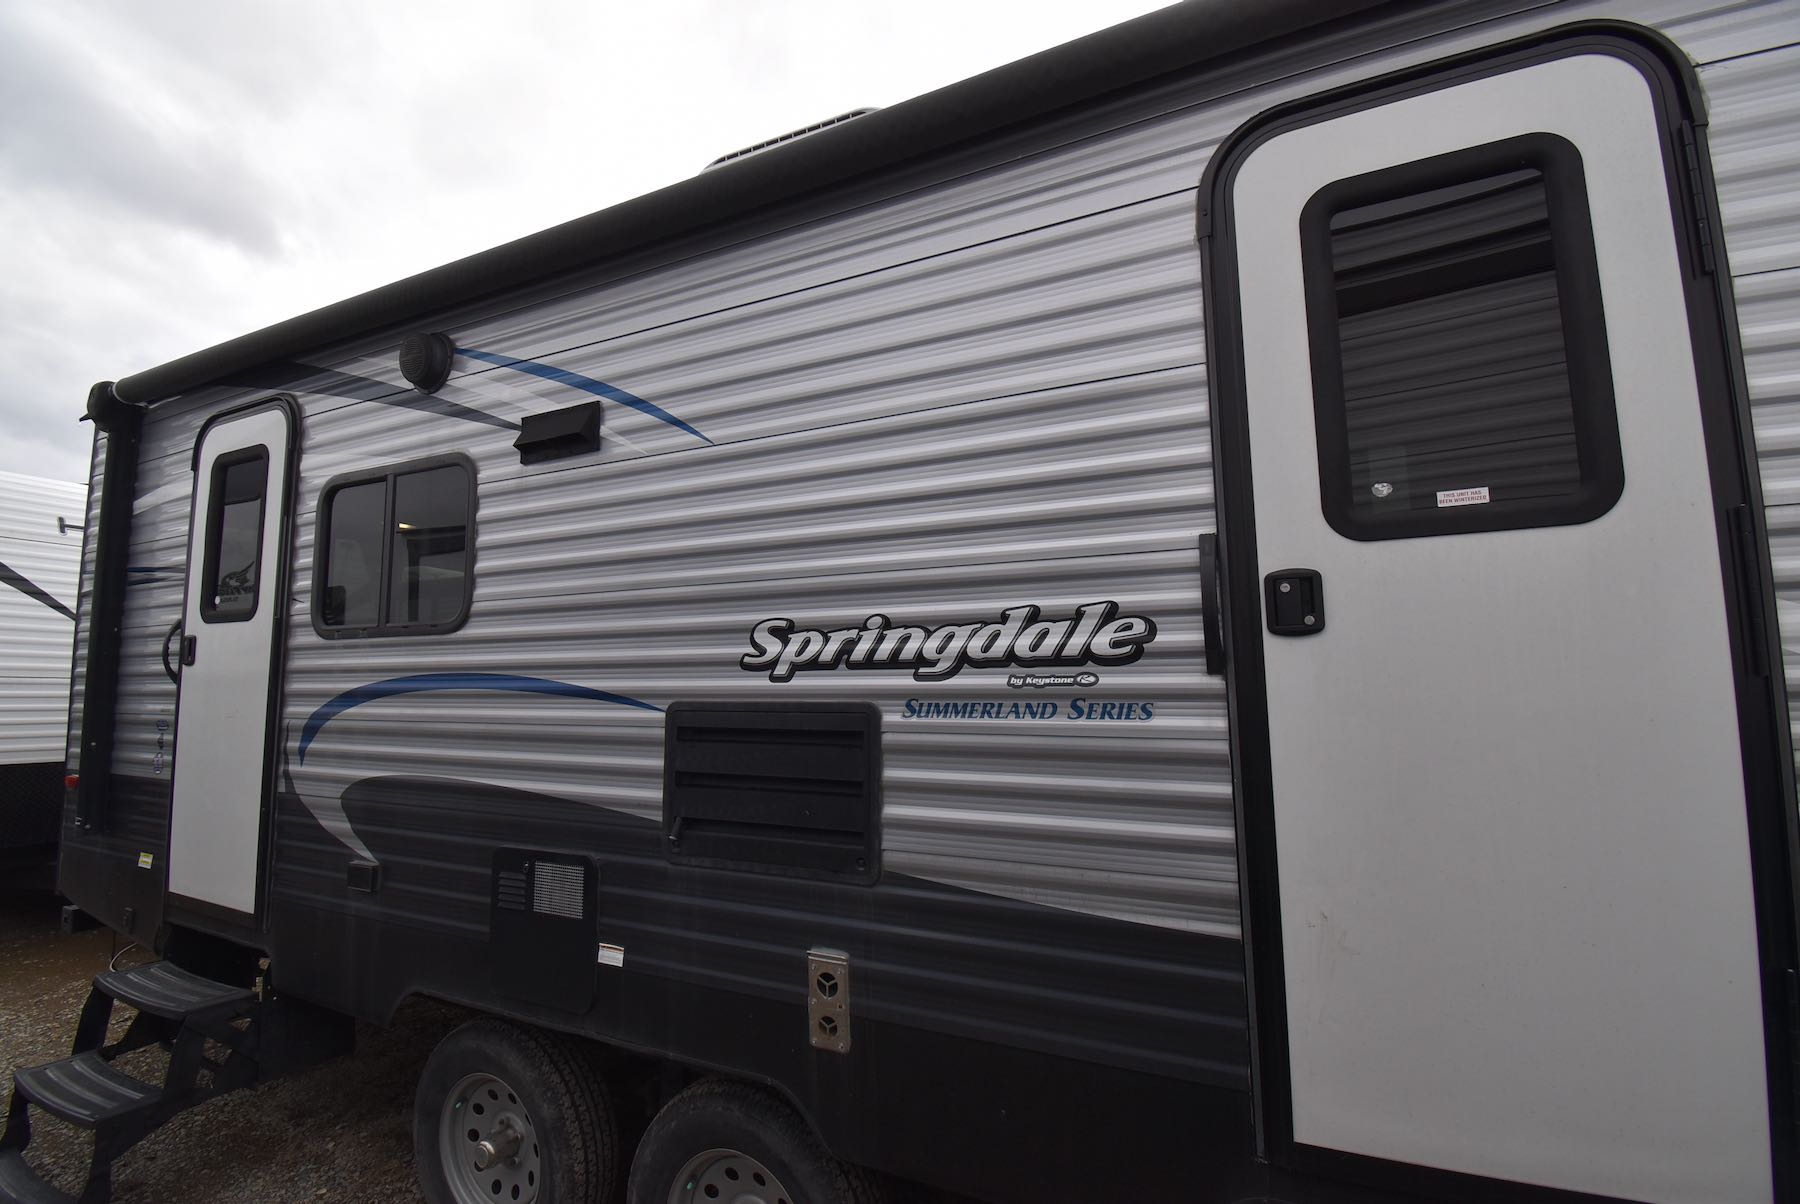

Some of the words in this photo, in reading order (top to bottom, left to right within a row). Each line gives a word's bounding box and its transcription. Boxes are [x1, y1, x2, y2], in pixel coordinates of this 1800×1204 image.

[740, 601, 1156, 682] Springdale
[1010, 676, 1023, 686] by
[1025, 677, 1074, 686] Keystone
[902, 699, 1058, 720] SUMMERLAND
[1067, 698, 1154, 720] SERIES
